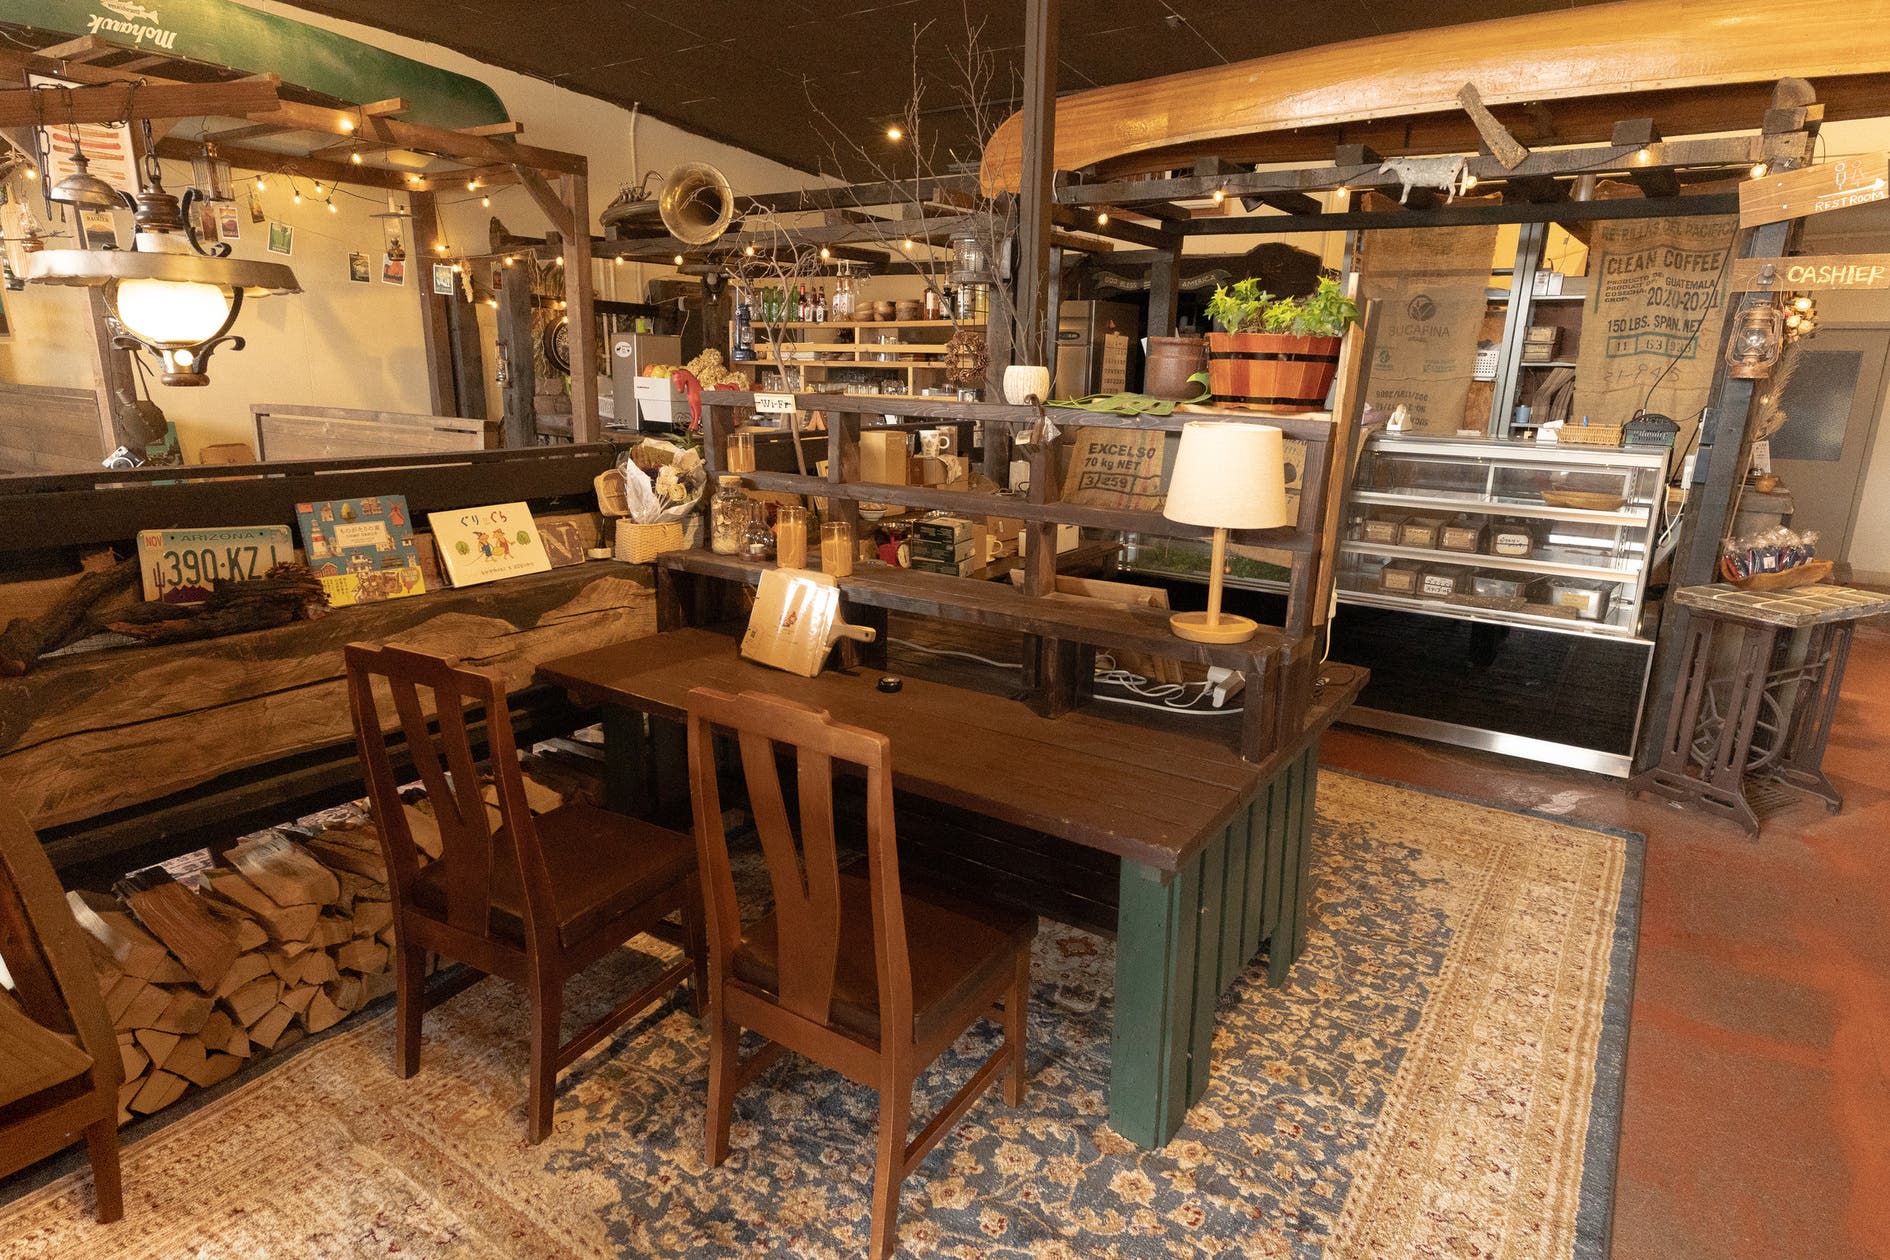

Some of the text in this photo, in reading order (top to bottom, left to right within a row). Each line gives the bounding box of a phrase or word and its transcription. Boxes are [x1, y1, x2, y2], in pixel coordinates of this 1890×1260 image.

[87, 14, 177, 49] Mohawk
[1607, 249, 1721, 275] CLEAN COFFEE
[1181, 275, 1216, 288] AMERICA
[1665, 276, 1715, 289] GUATEMALA
[1787, 265, 1886, 286] CASHIER
[1646, 286, 1719, 311] 2020-2021
[1607, 319, 1627, 332] 150
[1088, 442, 1156, 459] EXCELSO
[1084, 457, 1141, 471] 70 kg NET
[145, 530, 255, 547] NOV ARIZONA
